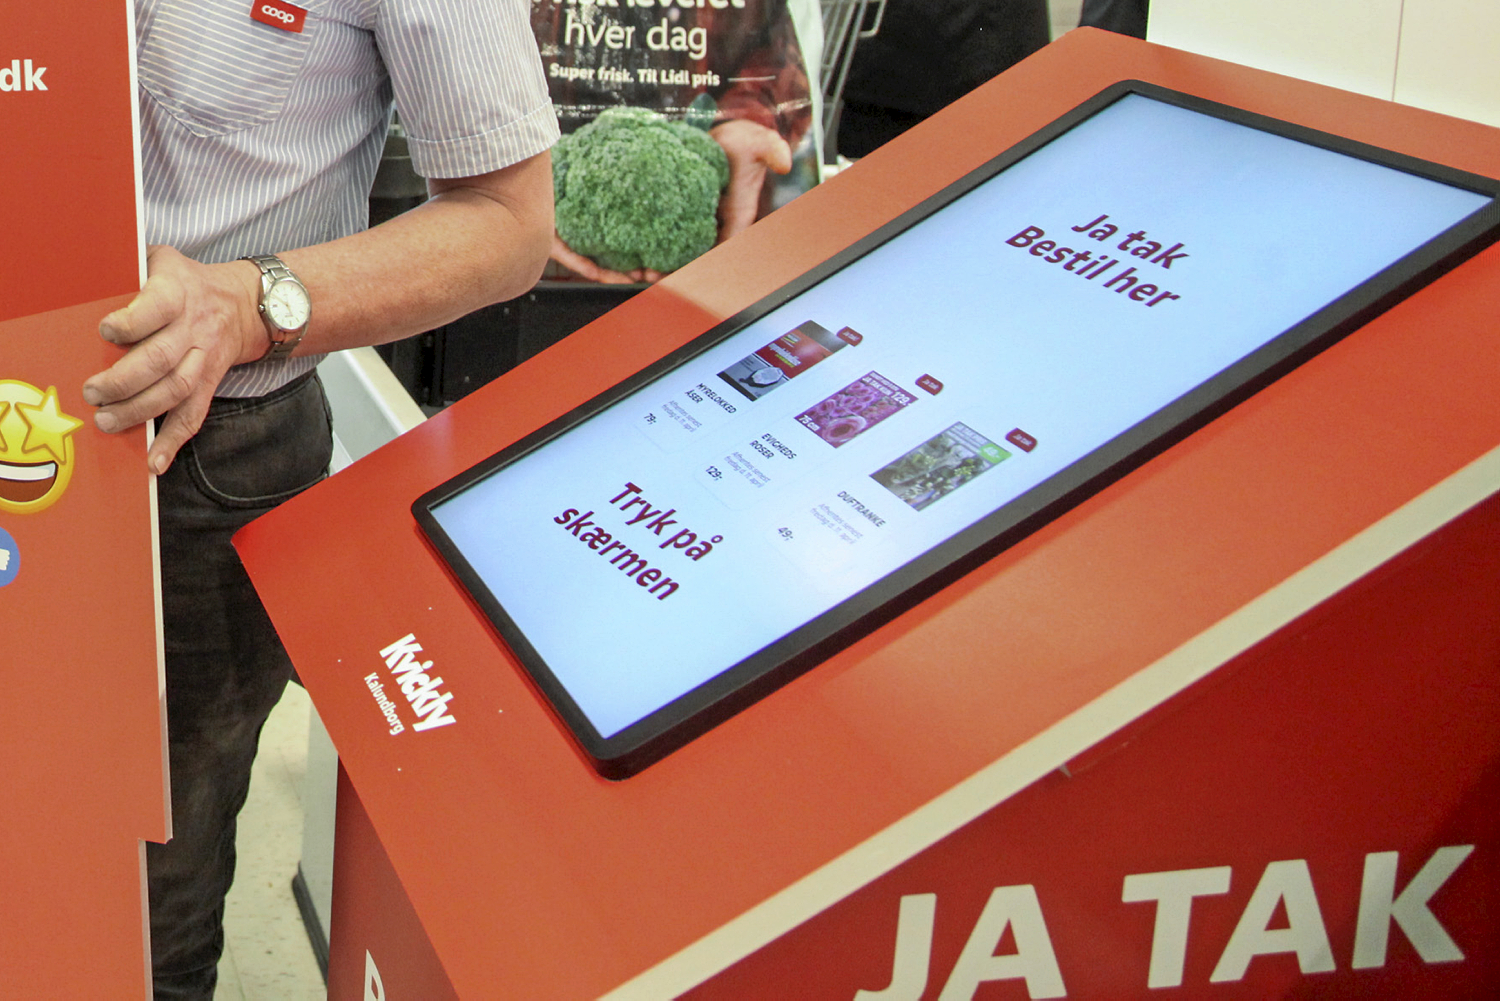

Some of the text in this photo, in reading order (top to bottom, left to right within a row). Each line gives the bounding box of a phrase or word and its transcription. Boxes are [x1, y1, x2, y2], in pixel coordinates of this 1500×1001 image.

[261, 4, 296, 24] coop
[564, 11, 708, 60] hver dag
[550, 62, 721, 89] Super frisk. Til Lidl pris
[1004, 225, 1182, 307] Bestil her
[1071, 214, 1190, 270] Ja tak
[696, 382, 737, 414] MYRELOKKED
[749, 440, 775, 459] ROSER
[761, 433, 797, 460] EVIGHEDS
[609, 481, 724, 562] Tryk på
[837, 490, 886, 528] DUFTRANKE
[553, 508, 680, 601] skærmen
[363, 671, 405, 736] Kalundborg
[379, 632, 457, 732] Kvickly
[853, 844, 1475, 1001] JA TAK
